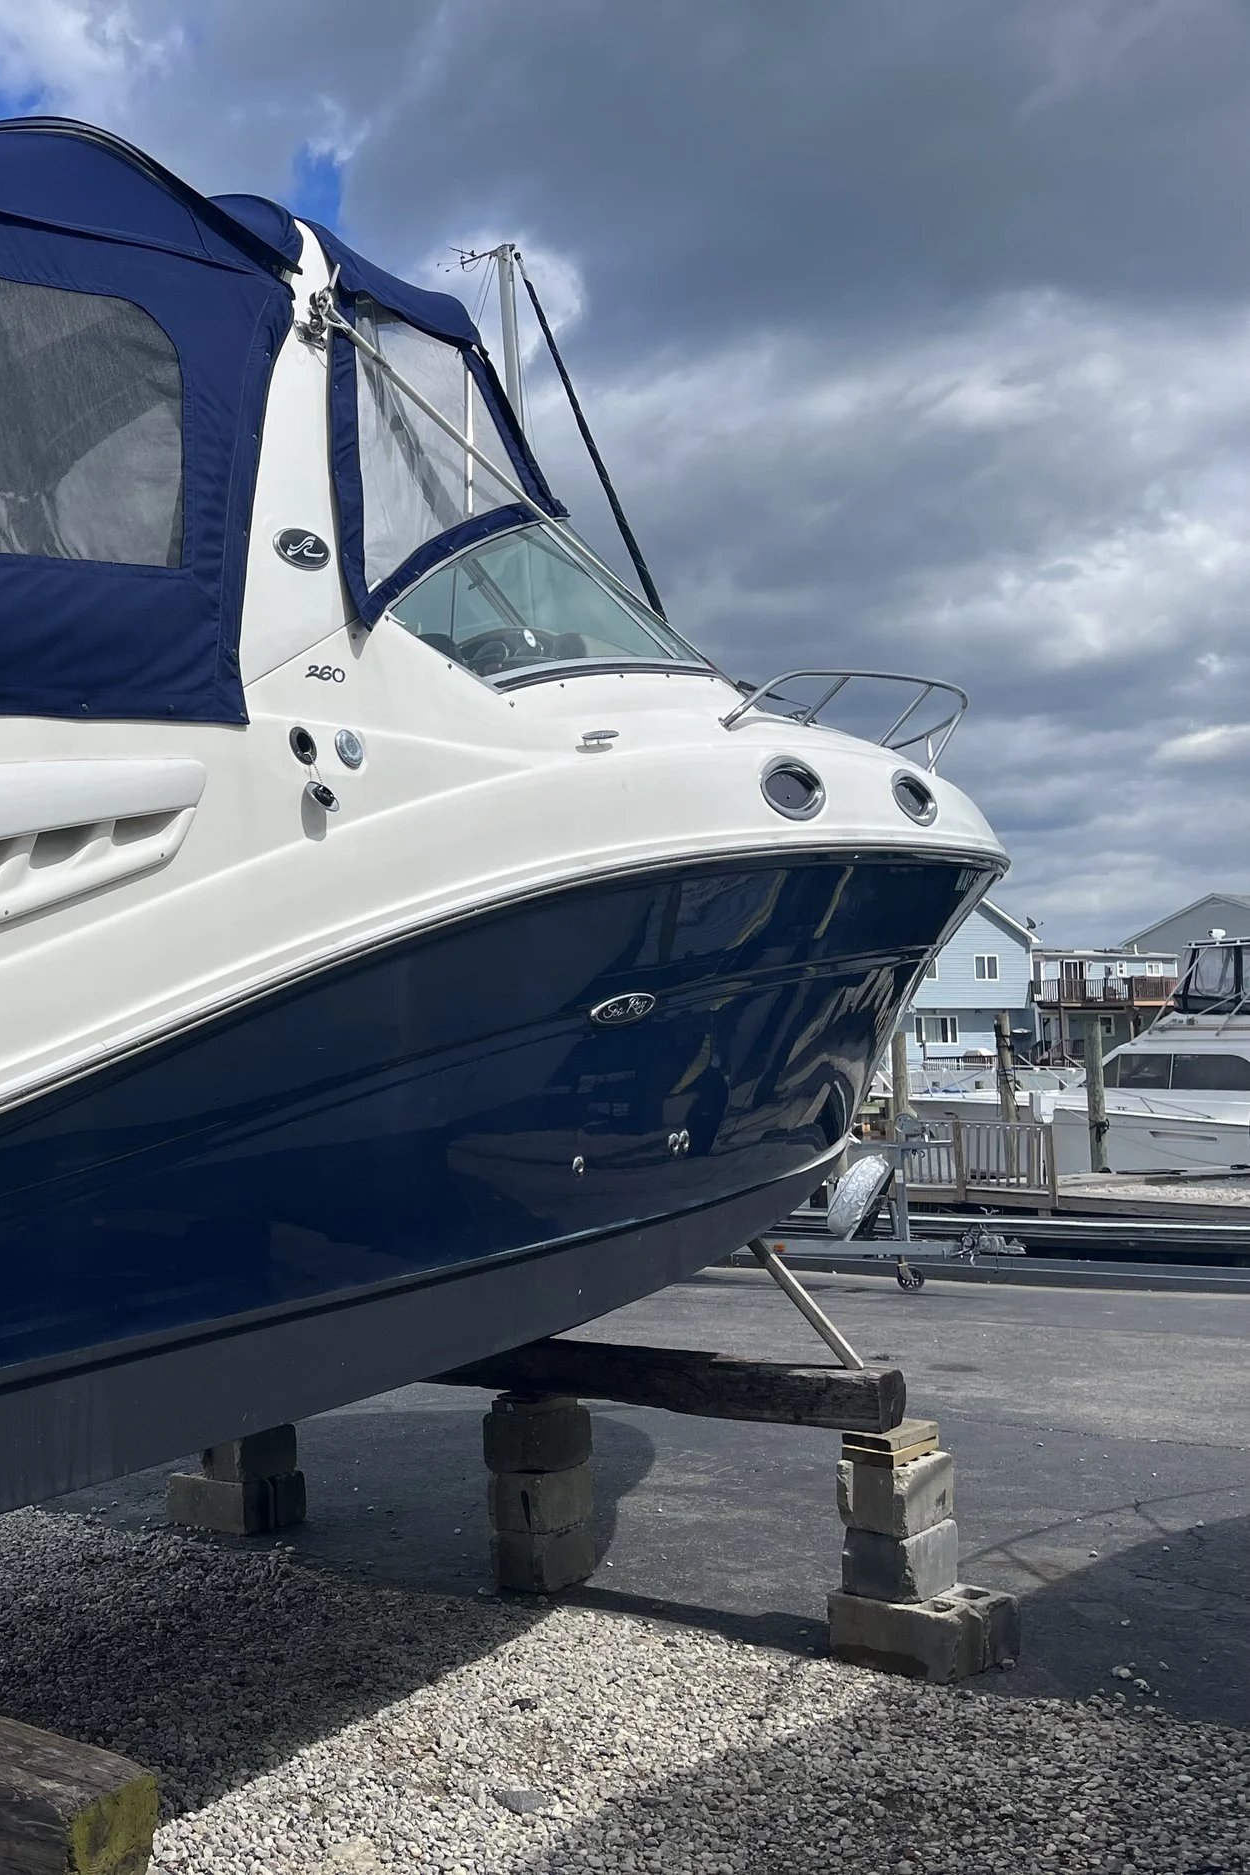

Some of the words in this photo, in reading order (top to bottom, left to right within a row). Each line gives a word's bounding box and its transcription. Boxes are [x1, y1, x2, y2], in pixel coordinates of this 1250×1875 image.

[305, 665, 345, 683] 260
[603, 1003, 625, 1018] Sea
[626, 997, 647, 1015] Ray
